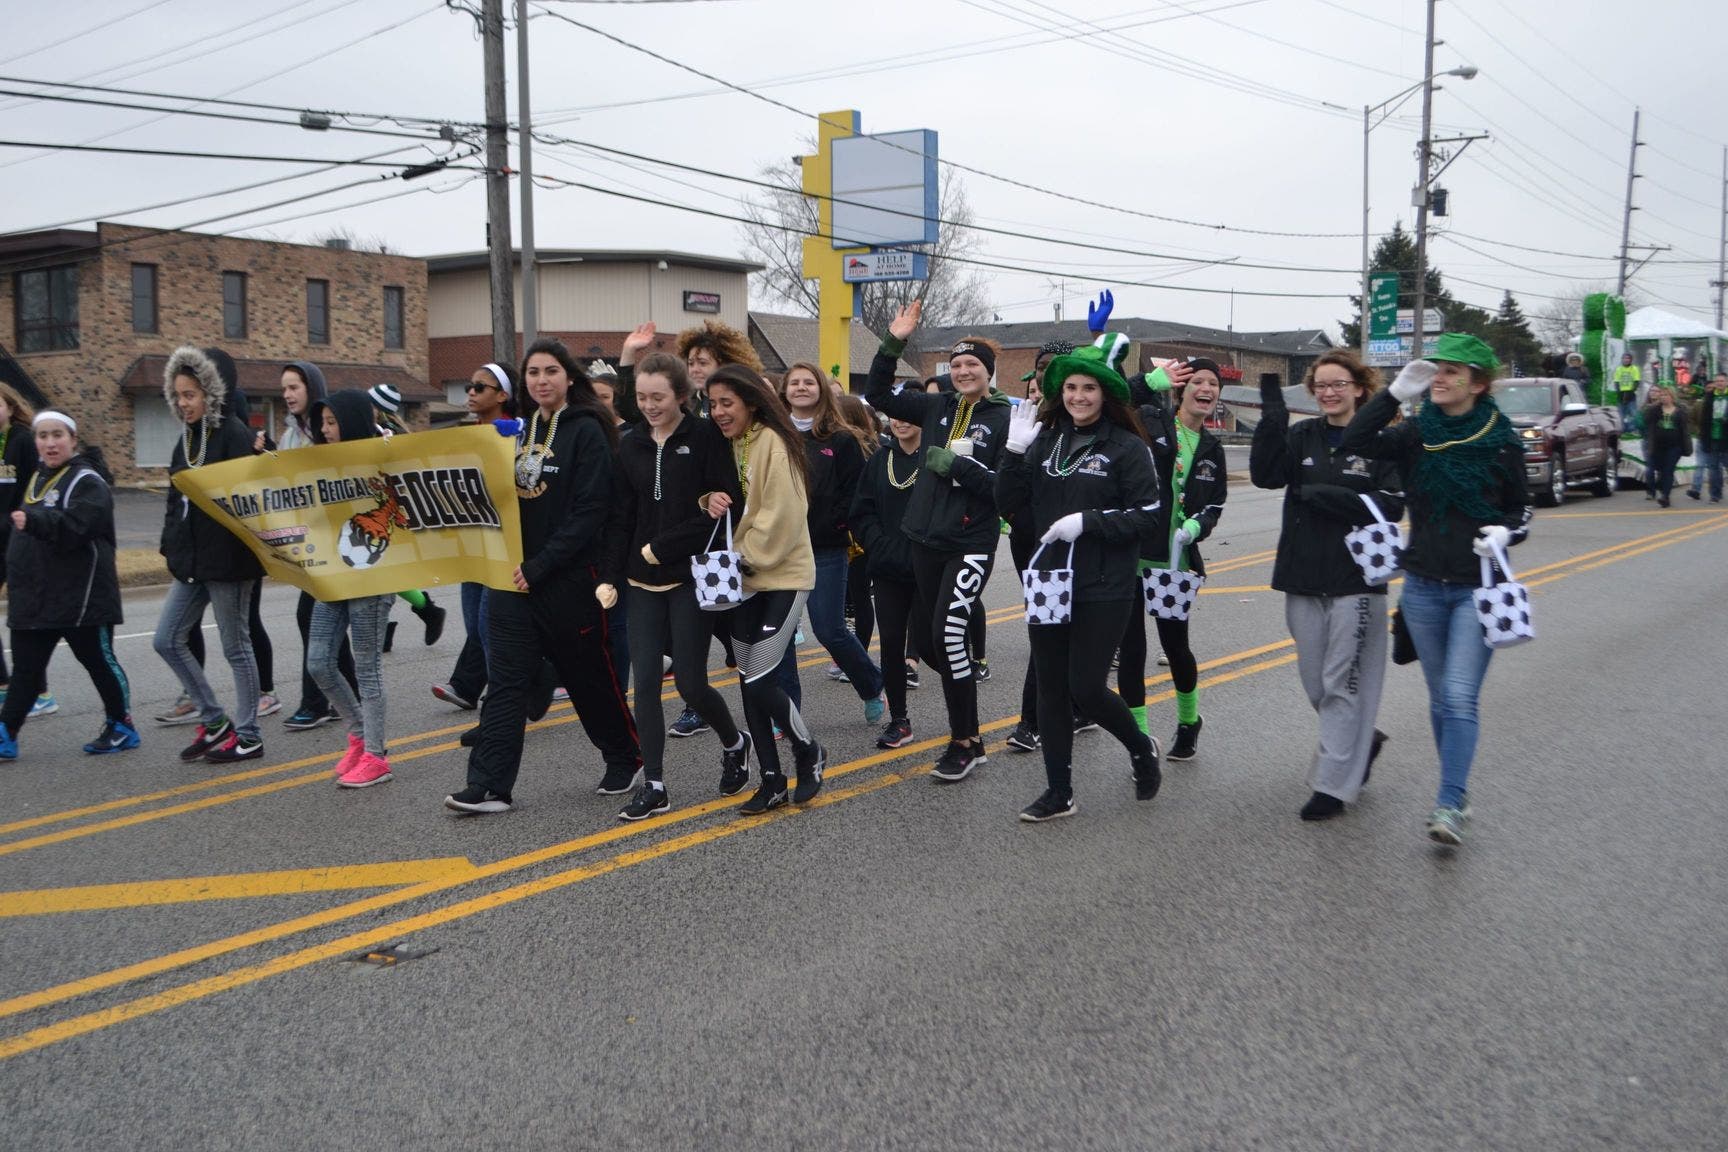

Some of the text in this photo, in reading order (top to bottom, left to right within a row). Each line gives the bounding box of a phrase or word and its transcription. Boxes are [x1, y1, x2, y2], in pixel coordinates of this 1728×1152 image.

[1368, 342, 1399, 351] ATTOO
[231, 493, 260, 520] OAK
[261, 483, 318, 513] FOREST
[385, 467, 501, 531] SOCCER
